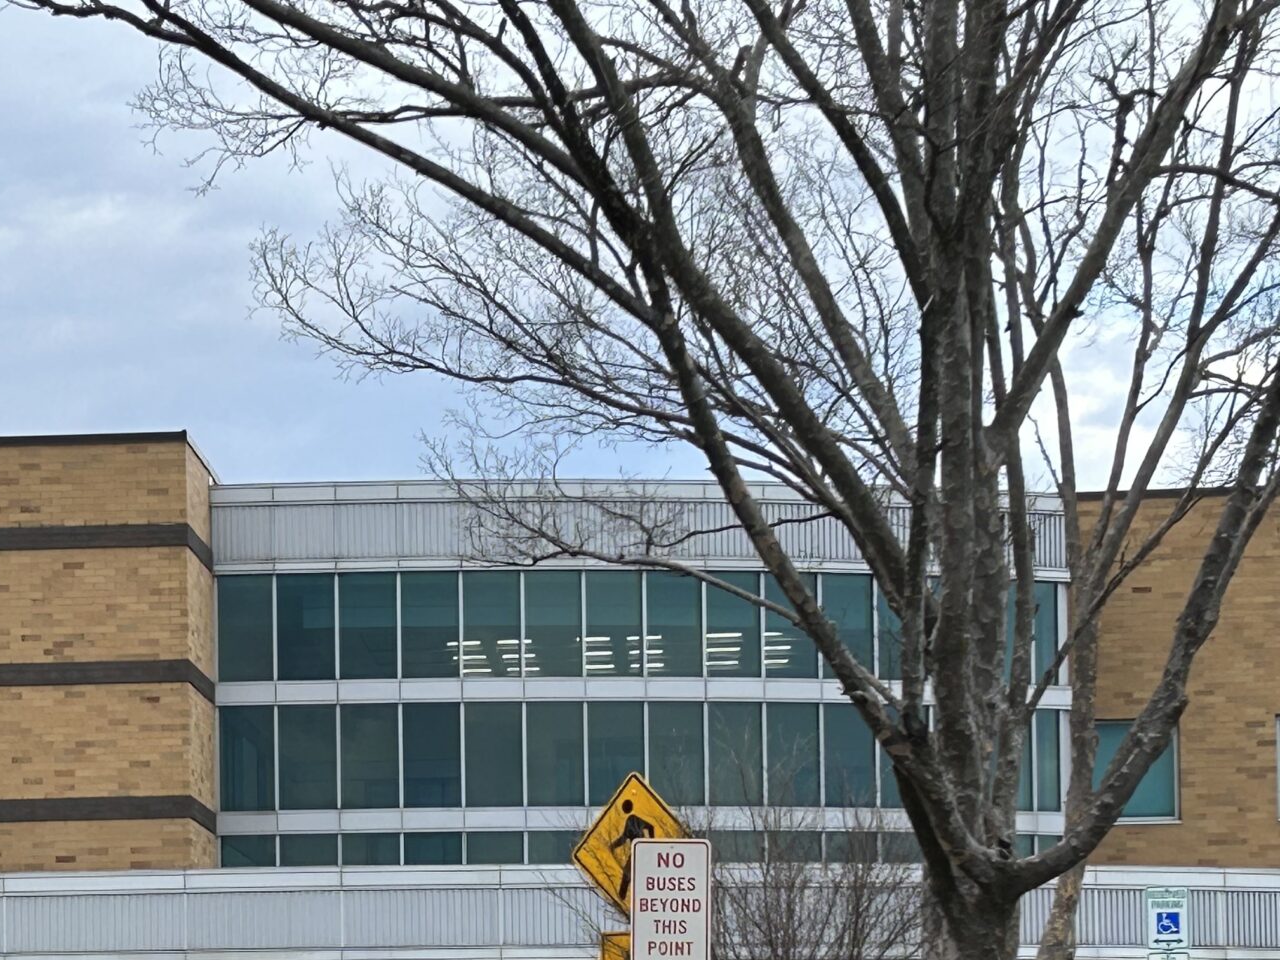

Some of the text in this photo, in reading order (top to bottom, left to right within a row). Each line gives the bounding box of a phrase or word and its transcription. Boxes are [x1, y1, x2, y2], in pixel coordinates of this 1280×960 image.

[657, 852, 685, 868] NO
[646, 876, 696, 891] BUSES
[639, 898, 702, 912] BEYOND
[653, 920, 687, 934] THIS
[648, 941, 694, 956] POINT
